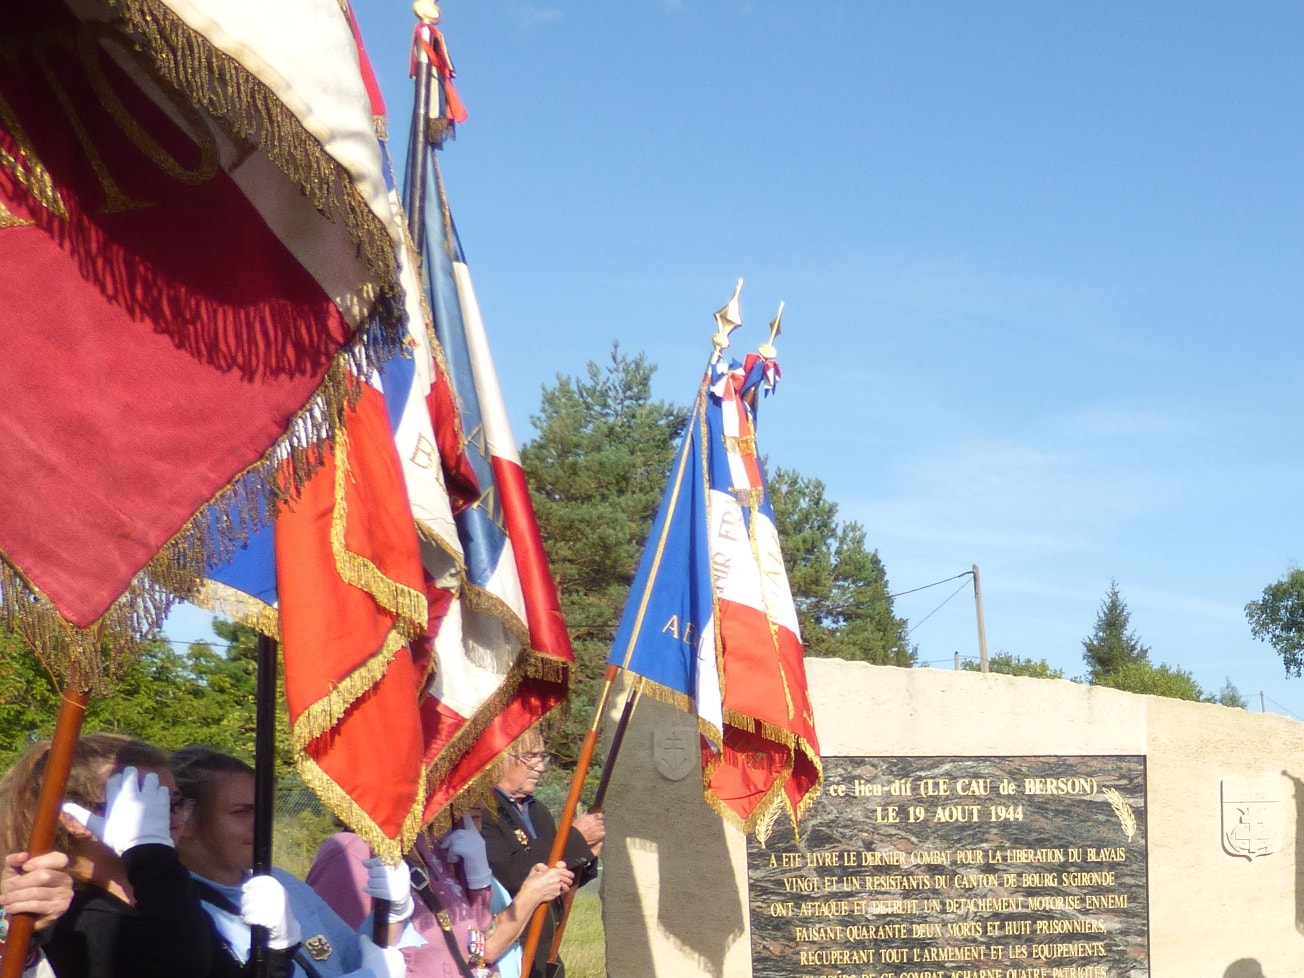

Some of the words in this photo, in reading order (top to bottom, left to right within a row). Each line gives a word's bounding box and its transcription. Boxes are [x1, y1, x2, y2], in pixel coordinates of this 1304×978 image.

[829, 784, 845, 796] ce
[855, 780, 911, 796] lieu-dit
[920, 779, 949, 797] (LE
[957, 779, 990, 796] CAU
[999, 779, 1016, 795] de
[1024, 778, 1097, 796] BERSON)
[876, 807, 898, 823] LE
[908, 807, 924, 822] 19
[934, 806, 981, 823] AOUT
[989, 806, 1023, 822] 1944
[769, 855, 777, 867] A
[783, 853, 801, 867] ETE
[807, 852, 839, 866] LIVRE
[844, 852, 857, 866] LE
[862, 852, 906, 865] DERNIER
[911, 851, 951, 865] COMBAT
[957, 850, 983, 863] POUR
[989, 850, 1001, 863] LA
[1007, 848, 1063, 863] LIBERATION
[1069, 848, 1081, 862] DU
[1087, 848, 1125, 862] BLAYAIS
[784, 877, 819, 892] VINGT
[825, 877, 841, 890] ET
[844, 877, 859, 890] UN
[866, 875, 930, 890] RESISTANTS
[935, 875, 949, 889] DU
[955, 874, 998, 888] CANTON
[1004, 873, 1017, 887] DE
[1022, 873, 1057, 887] BOURG
[771, 902, 794, 917] ONT
[800, 901, 848, 918] ATTAQUE
[854, 901, 866, 915] ET
[925, 899, 940, 913] UN
[946, 898, 1024, 912] DETACHEMENT
[1029, 896, 1081, 910] MOTORISE
[1086, 894, 1128, 909] ENNEMI
[796, 926, 842, 942] FAISANT
[846, 924, 907, 942] QUARANTE
[912, 924, 942, 938] DEUX
[948, 922, 982, 937] MORTS
[987, 921, 1000, 935] ET
[1005, 920, 1031, 935] HUIT
[800, 950, 874, 966] RECUPERANT
[879, 948, 908, 963] TOUT
[990, 946, 1004, 960] ET
[1009, 945, 1027, 959] LES
